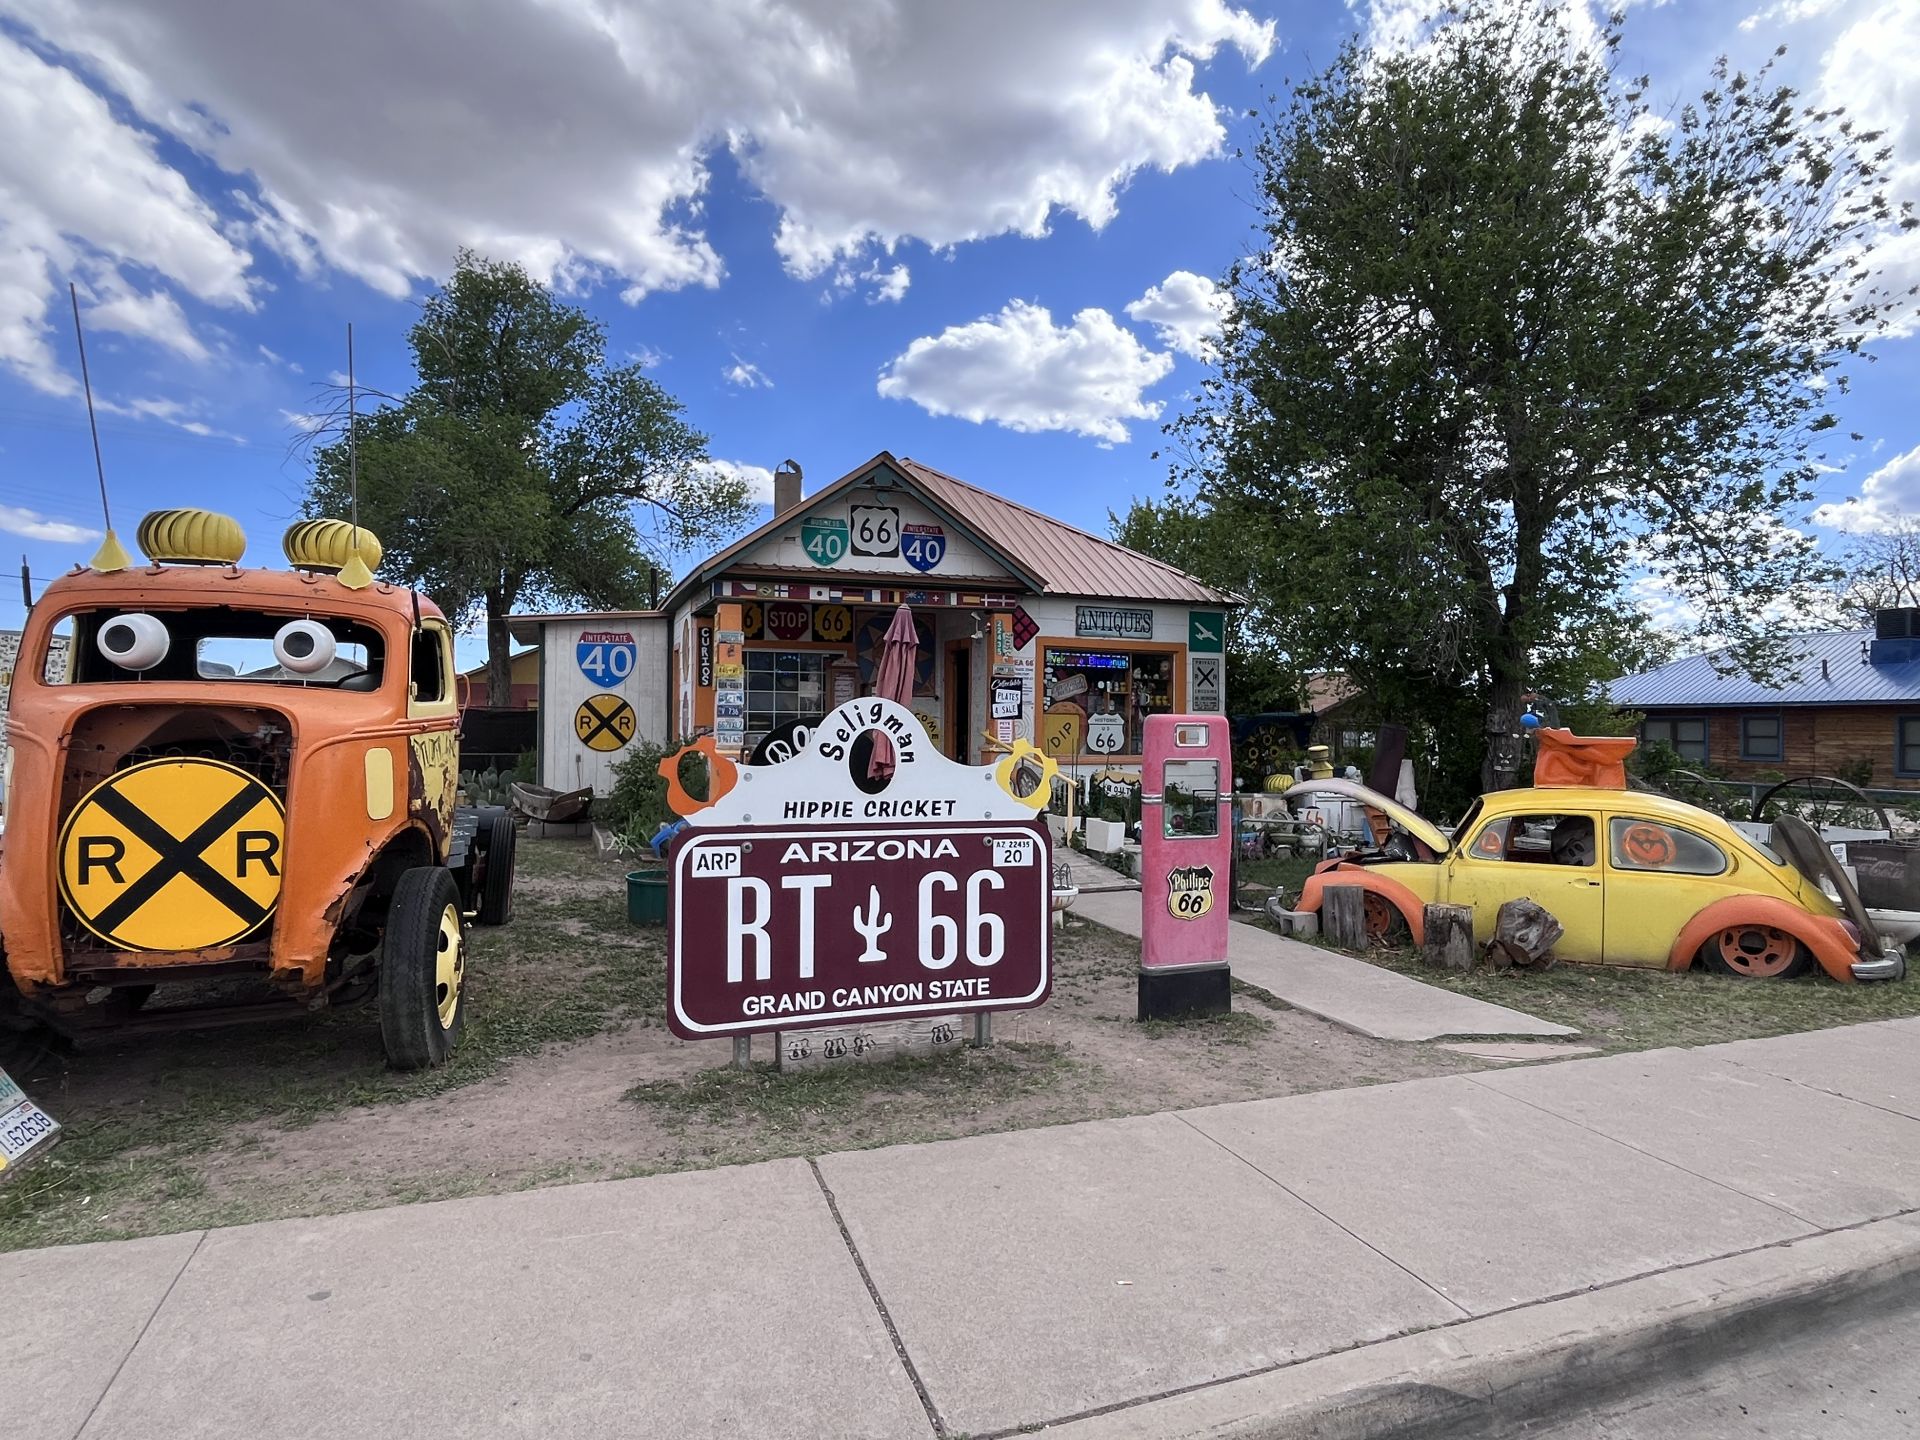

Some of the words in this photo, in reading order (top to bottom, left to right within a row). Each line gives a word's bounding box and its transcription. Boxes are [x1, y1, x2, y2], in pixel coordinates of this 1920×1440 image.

[860, 517, 891, 544] 66
[907, 526, 938, 534] INTERSTATE
[807, 534, 841, 558] 40
[907, 540, 939, 562] 40
[769, 611, 807, 627] STOP
[822, 609, 844, 631] 66
[1079, 611, 1151, 636] ANTIQUES
[581, 646, 632, 677] 40
[701, 628, 711, 686] CURIOS
[997, 691, 1019, 701] PLATES
[1002, 705, 1017, 713] SALE
[580, 716, 590, 729] R
[620, 717, 630, 729] R
[819, 703, 915, 762] Seligman
[1050, 722, 1072, 749] DIP
[1096, 733, 1116, 748] 66
[784, 801, 853, 818] HIPPIE
[864, 800, 956, 817] CRICKET
[78, 836, 126, 885] R
[237, 830, 280, 878] R
[697, 853, 737, 870] ARP
[780, 839, 960, 863] ARIZONA
[1004, 850, 1022, 863] 20
[1172, 873, 1209, 890] Phillips
[1179, 894, 1203, 913] 66
[727, 874, 832, 982] RT
[919, 870, 1004, 969] 66
[743, 991, 828, 1016] GRAND
[833, 983, 924, 1009] CANYON
[929, 978, 989, 997] STATE
[8, 1112, 51, 1147] 62638
